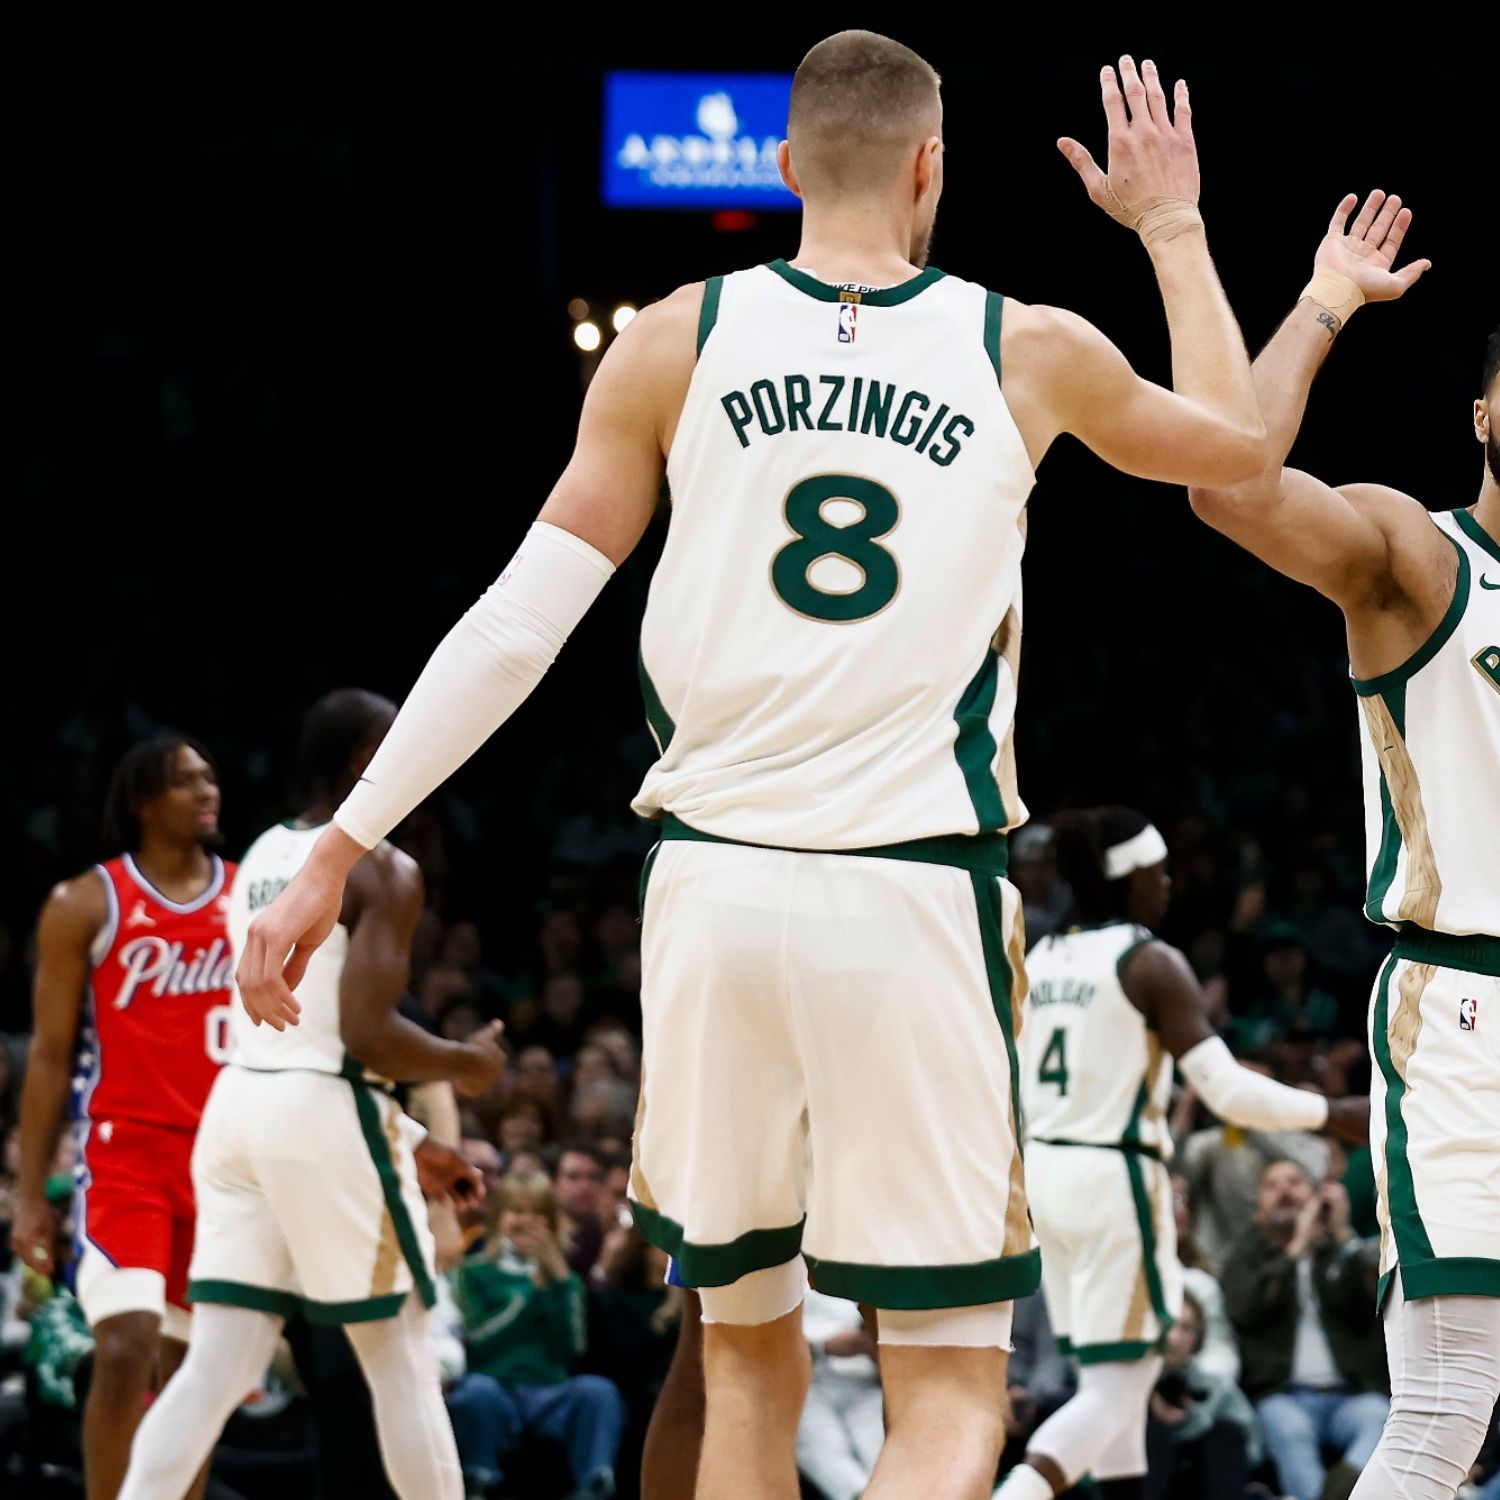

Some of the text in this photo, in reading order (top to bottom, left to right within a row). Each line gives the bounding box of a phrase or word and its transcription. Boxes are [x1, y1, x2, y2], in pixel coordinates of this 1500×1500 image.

[720, 374, 975, 466] PORZINGIS
[769, 471, 902, 624] 8
[1038, 1027, 1069, 1096] 4
